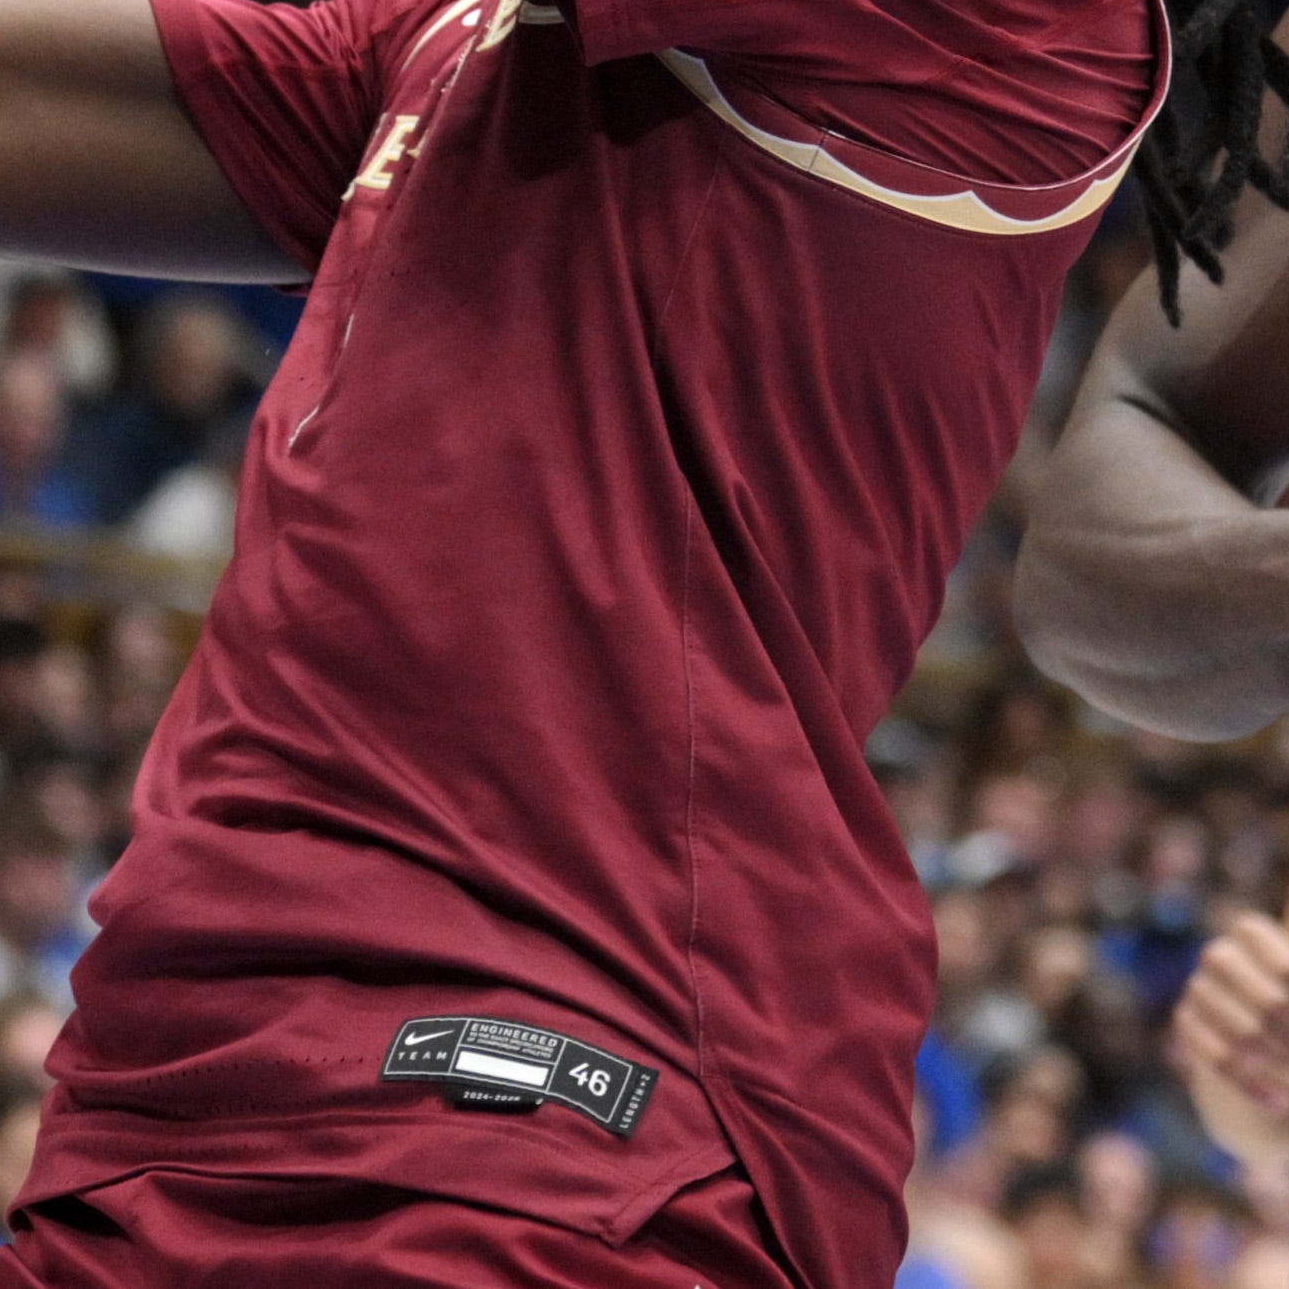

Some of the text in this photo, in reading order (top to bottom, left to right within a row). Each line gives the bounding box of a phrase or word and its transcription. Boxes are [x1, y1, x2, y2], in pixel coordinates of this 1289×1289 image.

[471, 1023, 558, 1047] ENGINEERED
[398, 1051, 447, 1061] TEAM
[569, 1062, 610, 1097] 46
